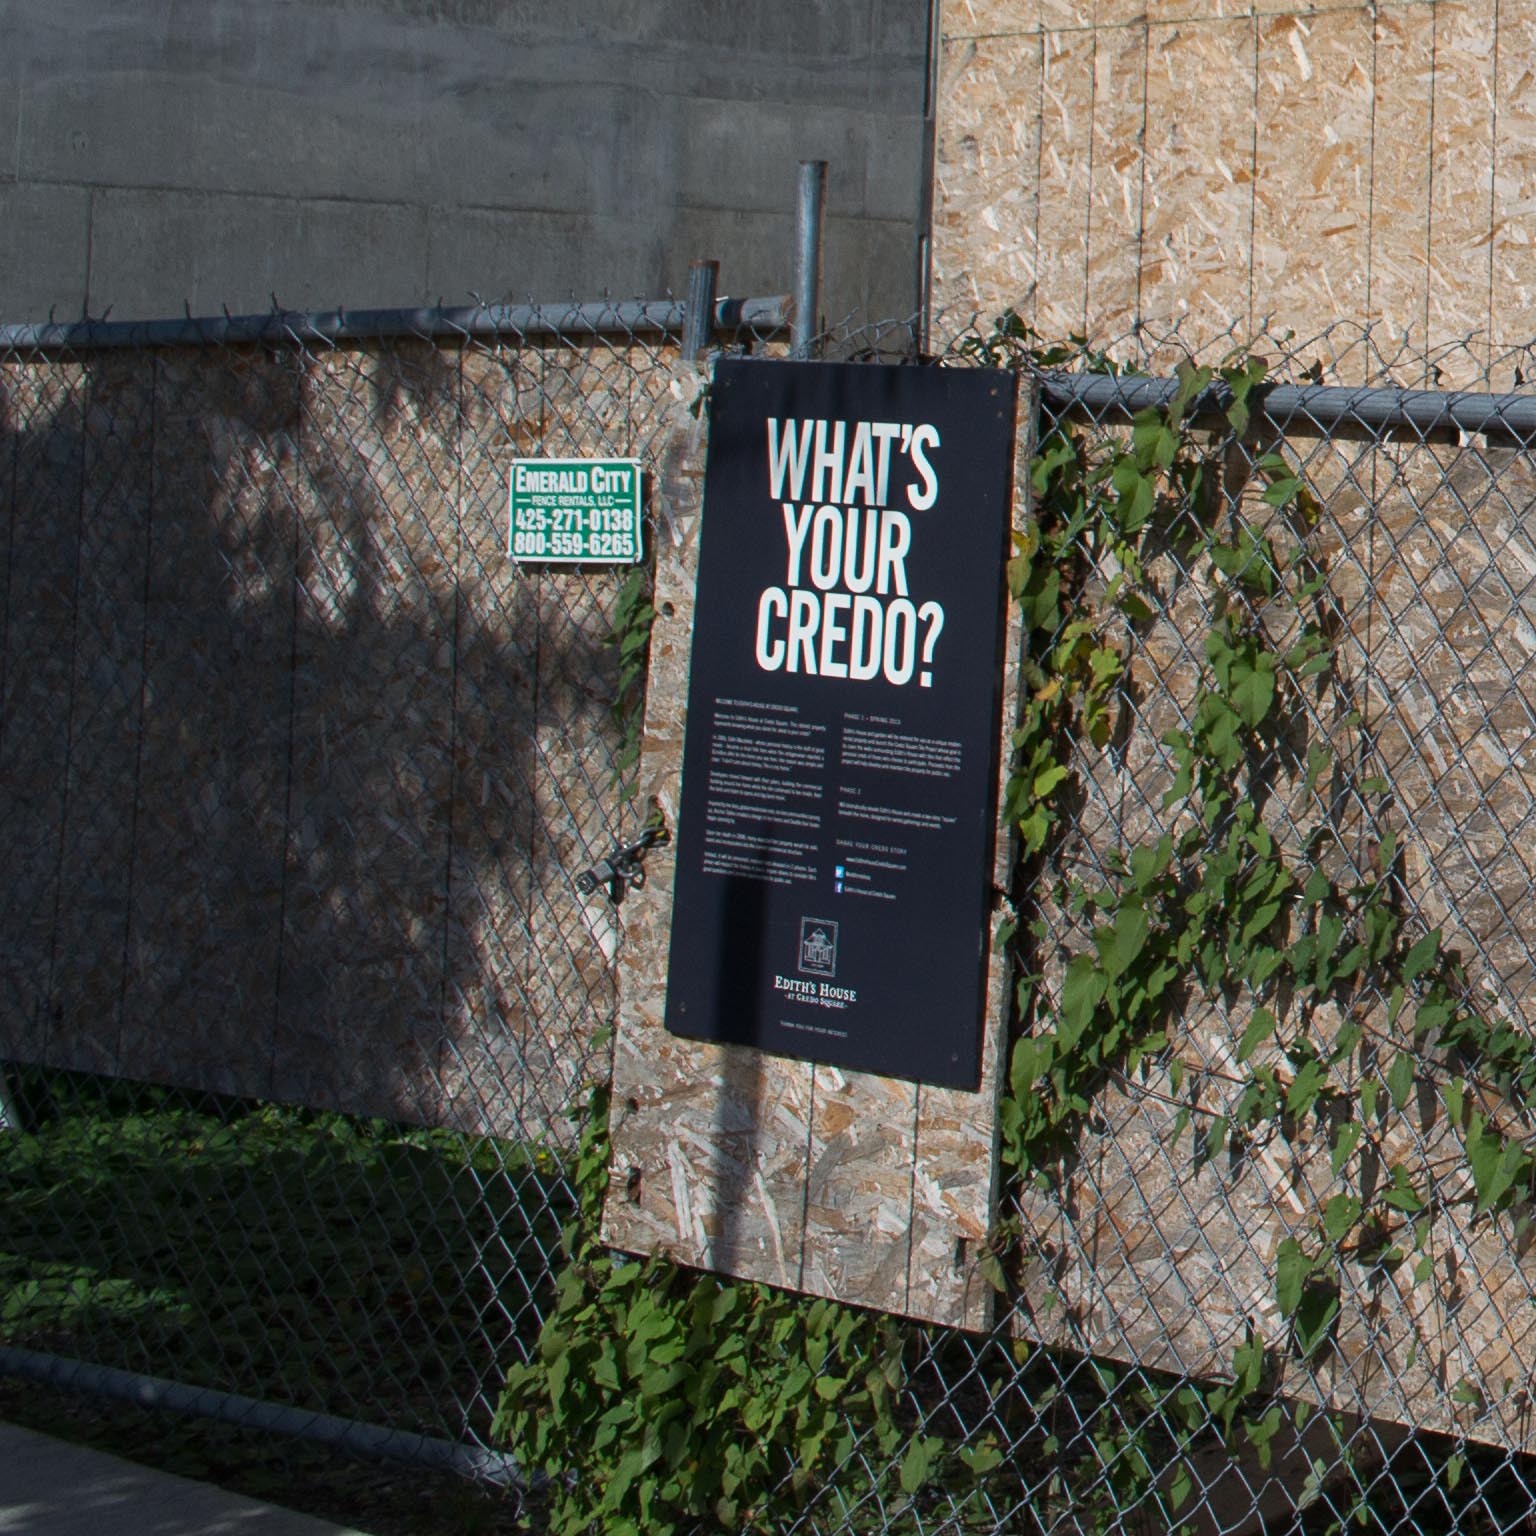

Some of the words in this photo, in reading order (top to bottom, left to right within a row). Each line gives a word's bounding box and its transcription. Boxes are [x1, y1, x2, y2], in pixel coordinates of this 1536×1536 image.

[766, 417, 942, 512] WHAT'S
[515, 466, 588, 493] EMERALD
[591, 466, 632, 493] CITY
[597, 496, 615, 506] LLC
[515, 508, 633, 531] 425-271-0138
[514, 531, 633, 555] 800-559-6265
[781, 502, 912, 597] YOUR
[754, 586, 946, 688] CREDO?
[774, 975, 817, 995] EDITH'S
[819, 983, 857, 1002] HOUSE
